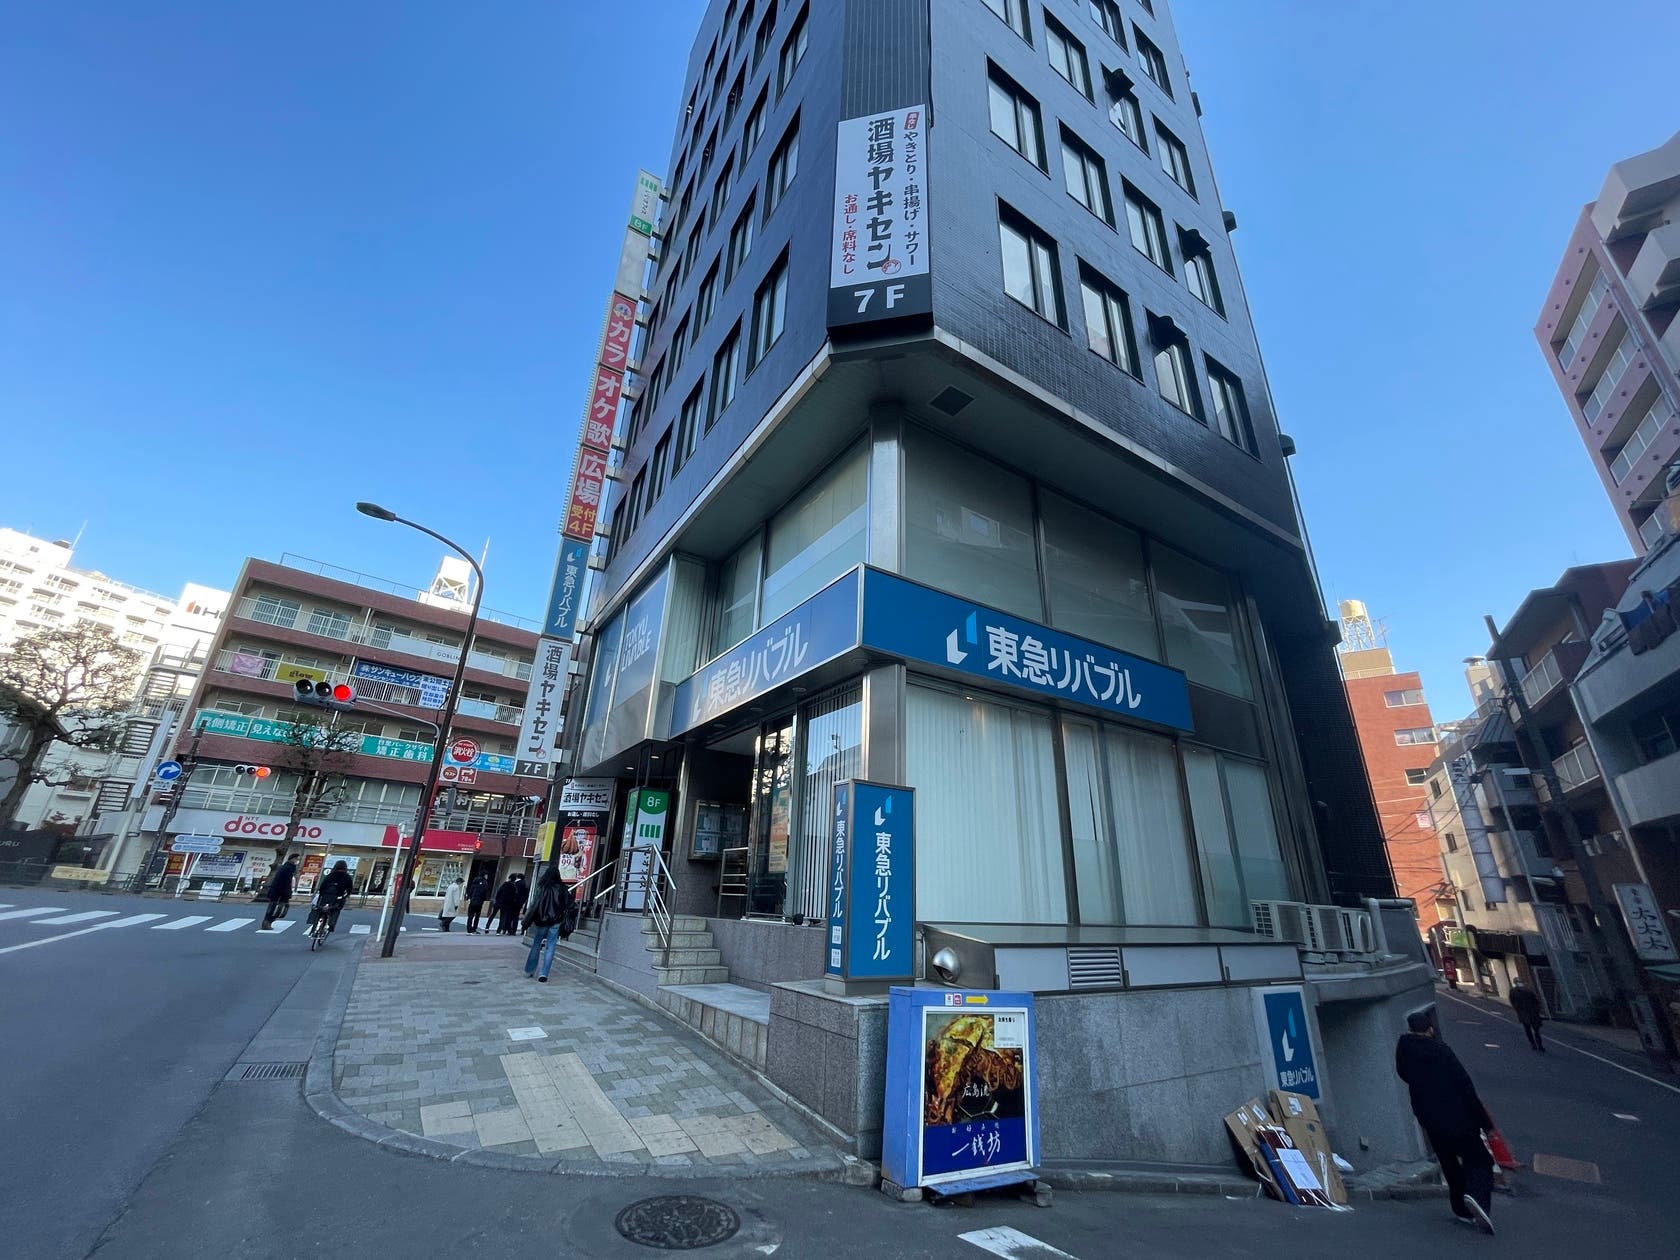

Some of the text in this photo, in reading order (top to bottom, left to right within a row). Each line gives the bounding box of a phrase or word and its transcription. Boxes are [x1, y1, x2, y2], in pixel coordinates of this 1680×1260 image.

[867, 117, 895, 271] 酒場ヤキセン
[904, 131, 920, 266] やきとり・串揚げ・サワー
[842, 194, 858, 275] お通し・席料なし
[854, 284, 905, 314] 7F
[569, 522, 593, 535] 4F
[571, 504, 597, 521] 受付
[554, 564, 579, 629] 東急リバブル
[528, 644, 564, 754] 酒場ヤキセン
[706, 622, 808, 710] 東急リバブル
[985, 625, 1141, 709] 東急リバブル
[453, 747, 475, 757] 消火栓
[523, 762, 543, 775] 7F
[647, 796, 661, 807] 8F
[832, 820, 846, 919] 東急リバブル
[872, 832, 892, 961] 東急リバブル
[1279, 1066, 1314, 1089] 東急リバブル
